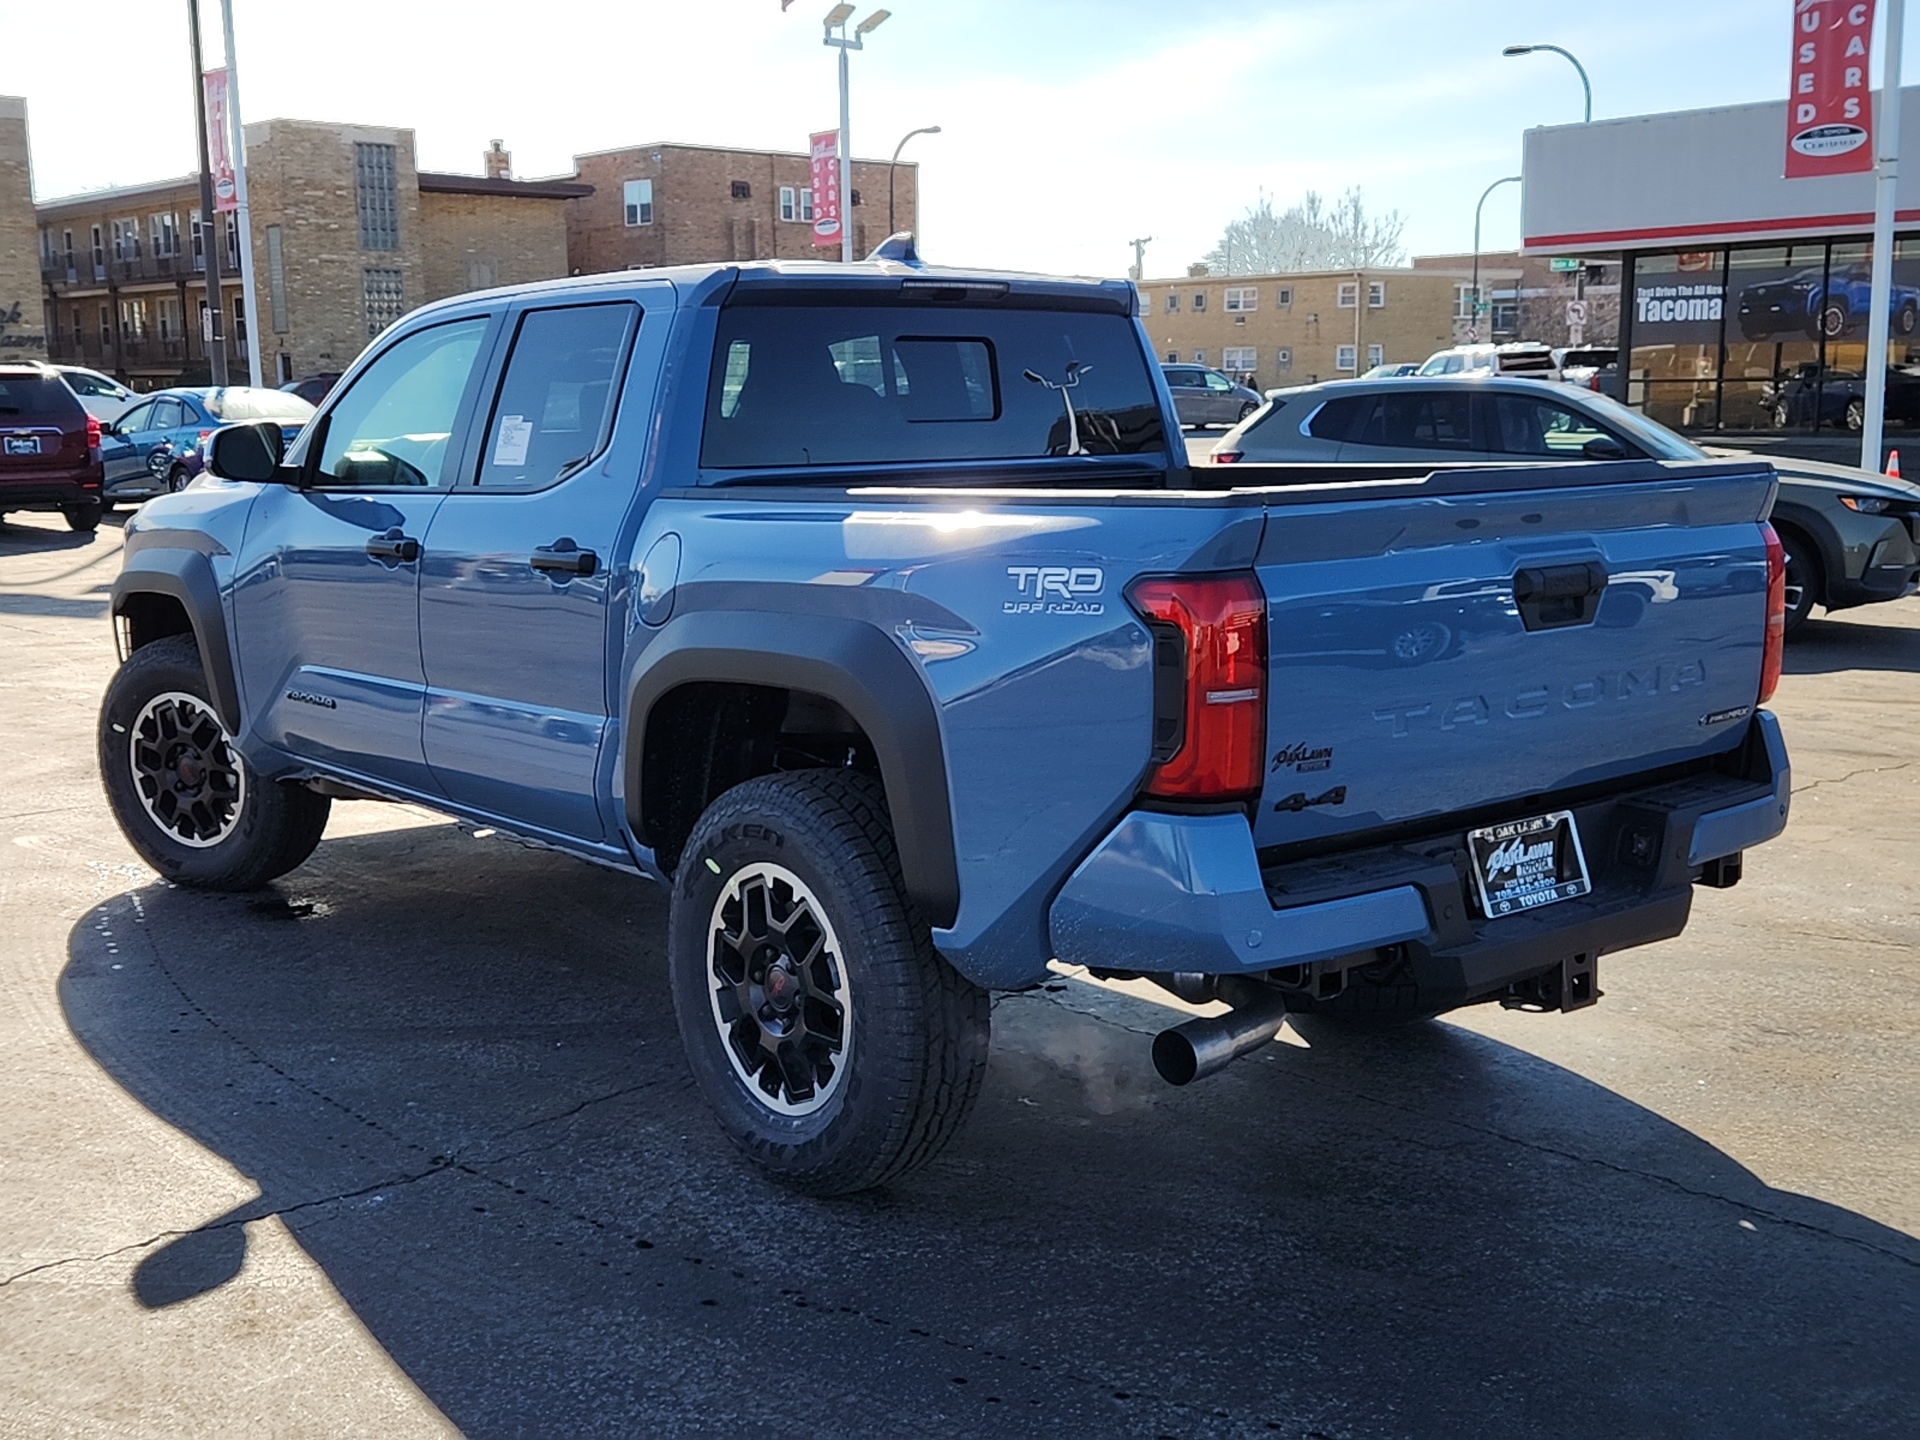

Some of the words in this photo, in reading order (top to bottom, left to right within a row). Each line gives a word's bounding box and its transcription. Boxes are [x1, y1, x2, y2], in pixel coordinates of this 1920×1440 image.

[1797, 11, 1820, 124] USED
[1844, 4, 1868, 119] CARS
[813, 162, 823, 219] USED
[827, 159, 836, 217] CARS
[1655, 286, 1677, 297] Drive
[1677, 285, 1693, 296] The
[1693, 285, 1706, 296] All
[1636, 298, 1723, 322] Tacoma
[1006, 567, 1104, 599] TRD
[1002, 602, 1044, 614] OFF
[1045, 602, 1105, 615] ROAD
[285, 690, 336, 709] TACOMA
[1371, 658, 1706, 738] TACOMA
[1496, 823, 1517, 839] OAK
[1517, 819, 1544, 835] LAWN
[1518, 888, 1559, 907] TOYOTA
